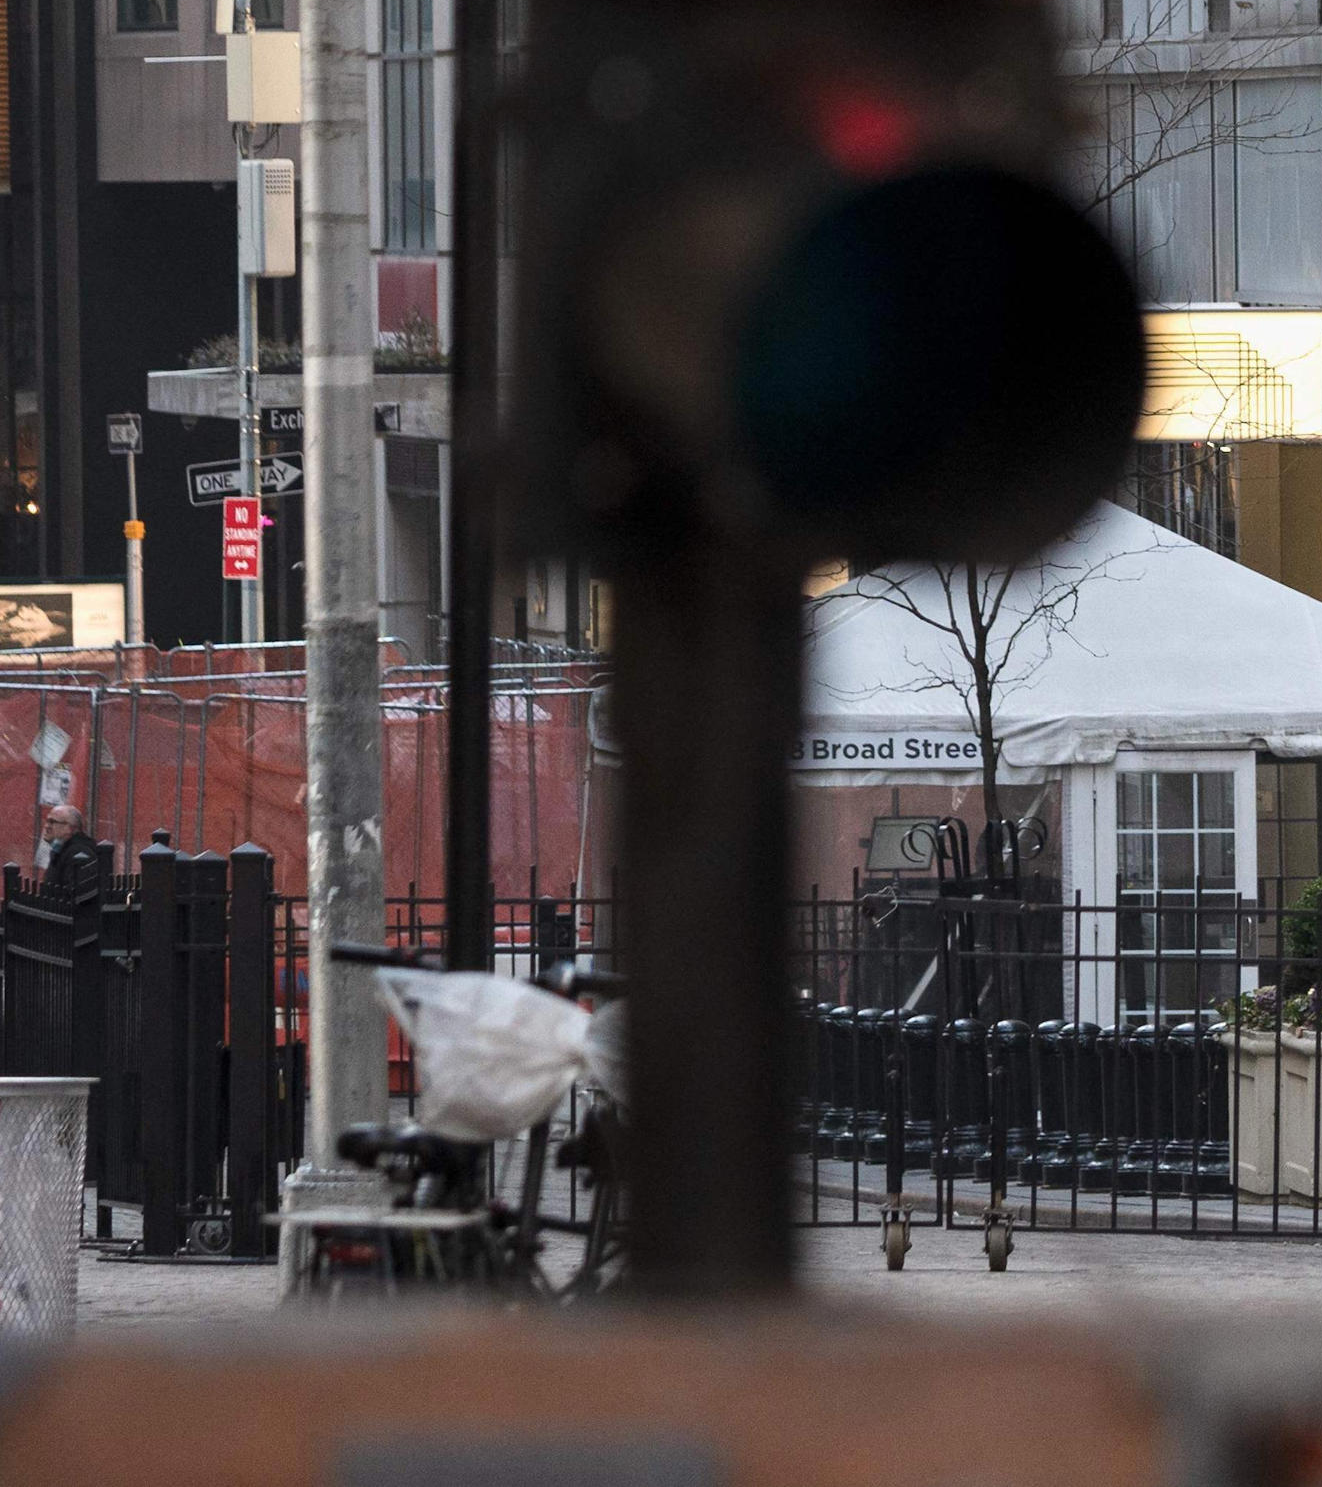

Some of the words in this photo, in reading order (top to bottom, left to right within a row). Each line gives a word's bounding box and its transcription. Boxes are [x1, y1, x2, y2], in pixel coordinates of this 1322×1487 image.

[200, 475, 233, 491] ONE
[235, 507, 249, 523] NO
[225, 527, 262, 541] STANDING
[227, 544, 257, 558] ANYTIME
[812, 737, 895, 759] Broad
